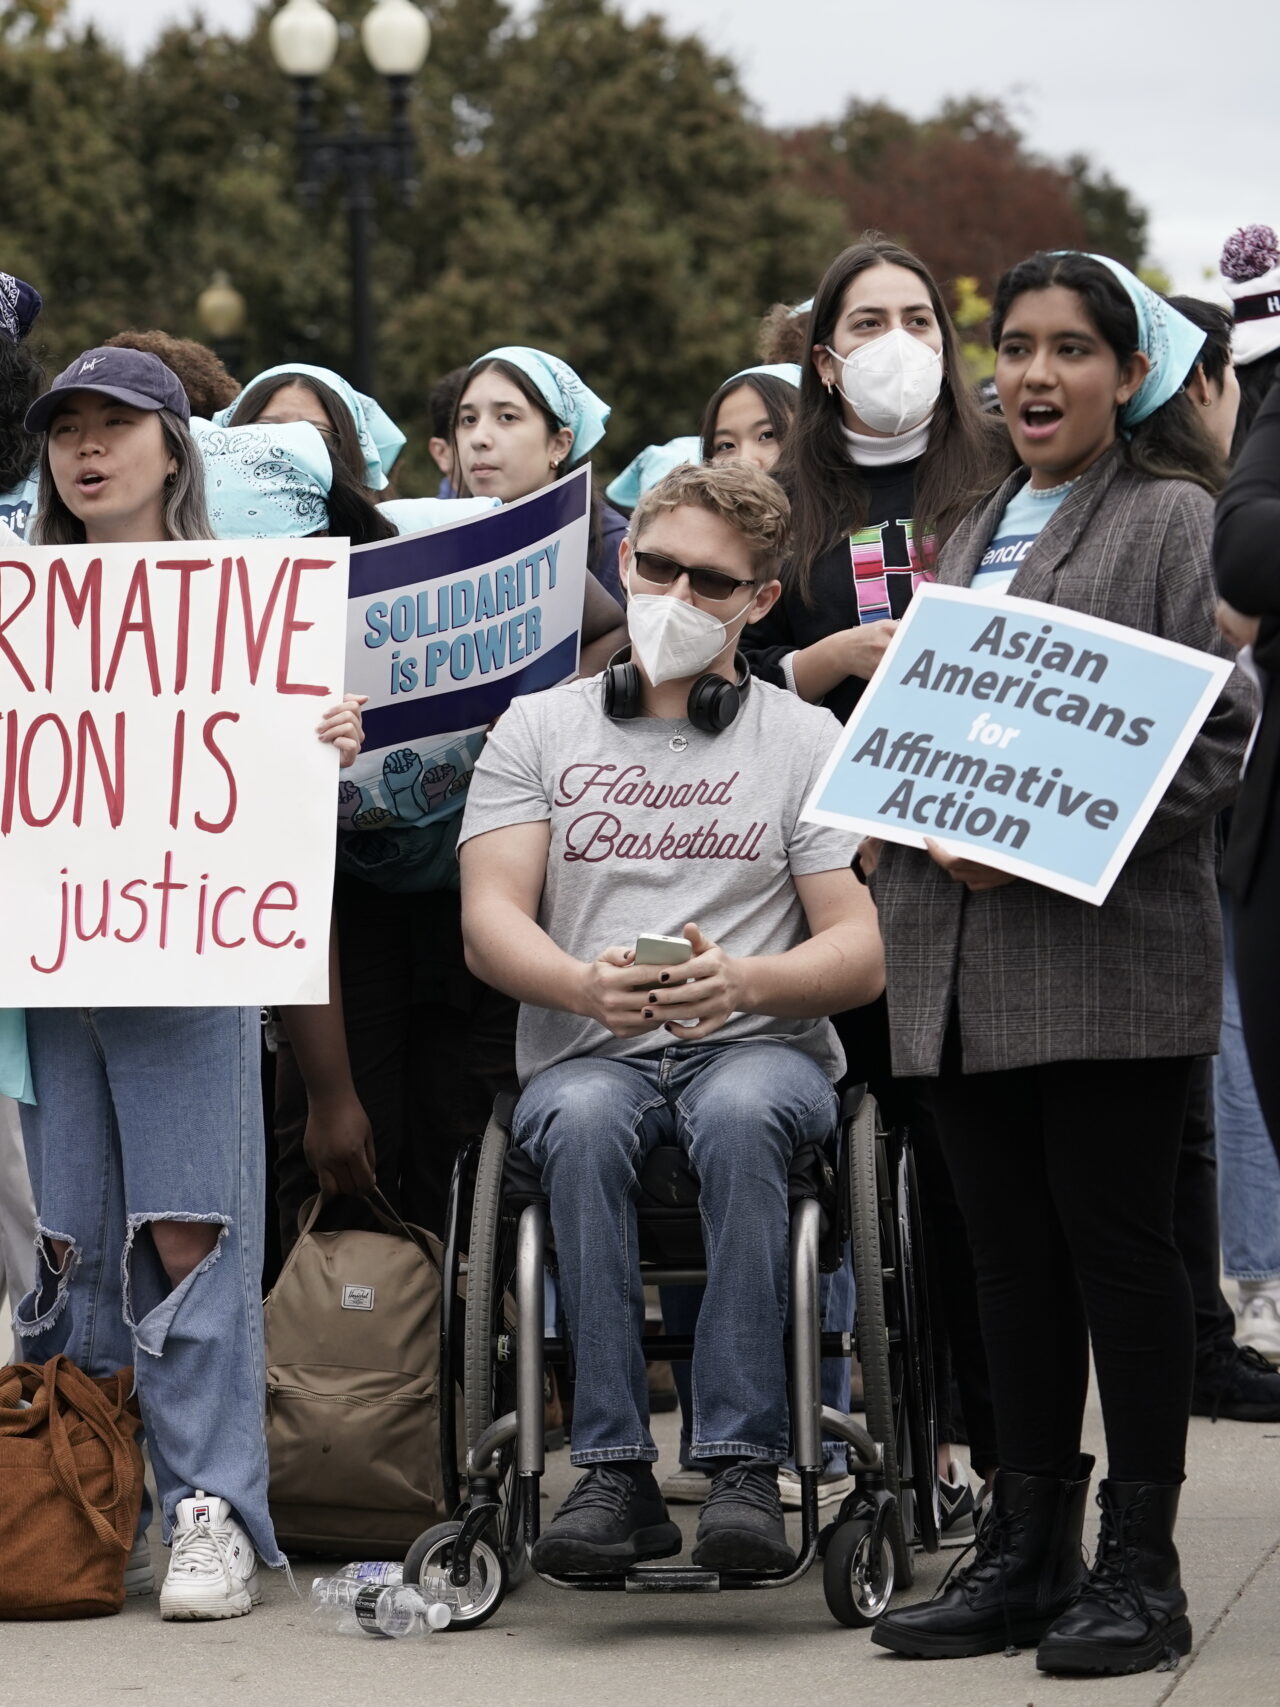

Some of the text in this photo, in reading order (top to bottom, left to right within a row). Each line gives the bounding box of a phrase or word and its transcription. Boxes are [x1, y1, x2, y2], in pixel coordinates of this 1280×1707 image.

[364, 540, 561, 649] SOLIDARITY
[390, 606, 542, 694] is POWER
[970, 616, 1109, 683] Asian
[899, 649, 1156, 747] Americans
[967, 713, 1019, 750] for
[169, 709, 240, 834] IS
[554, 763, 739, 809] Harvard
[851, 727, 1119, 831] Affirmative
[877, 779, 1031, 850] Action
[563, 811, 768, 863] Basketball
[30, 851, 308, 974] justice.
